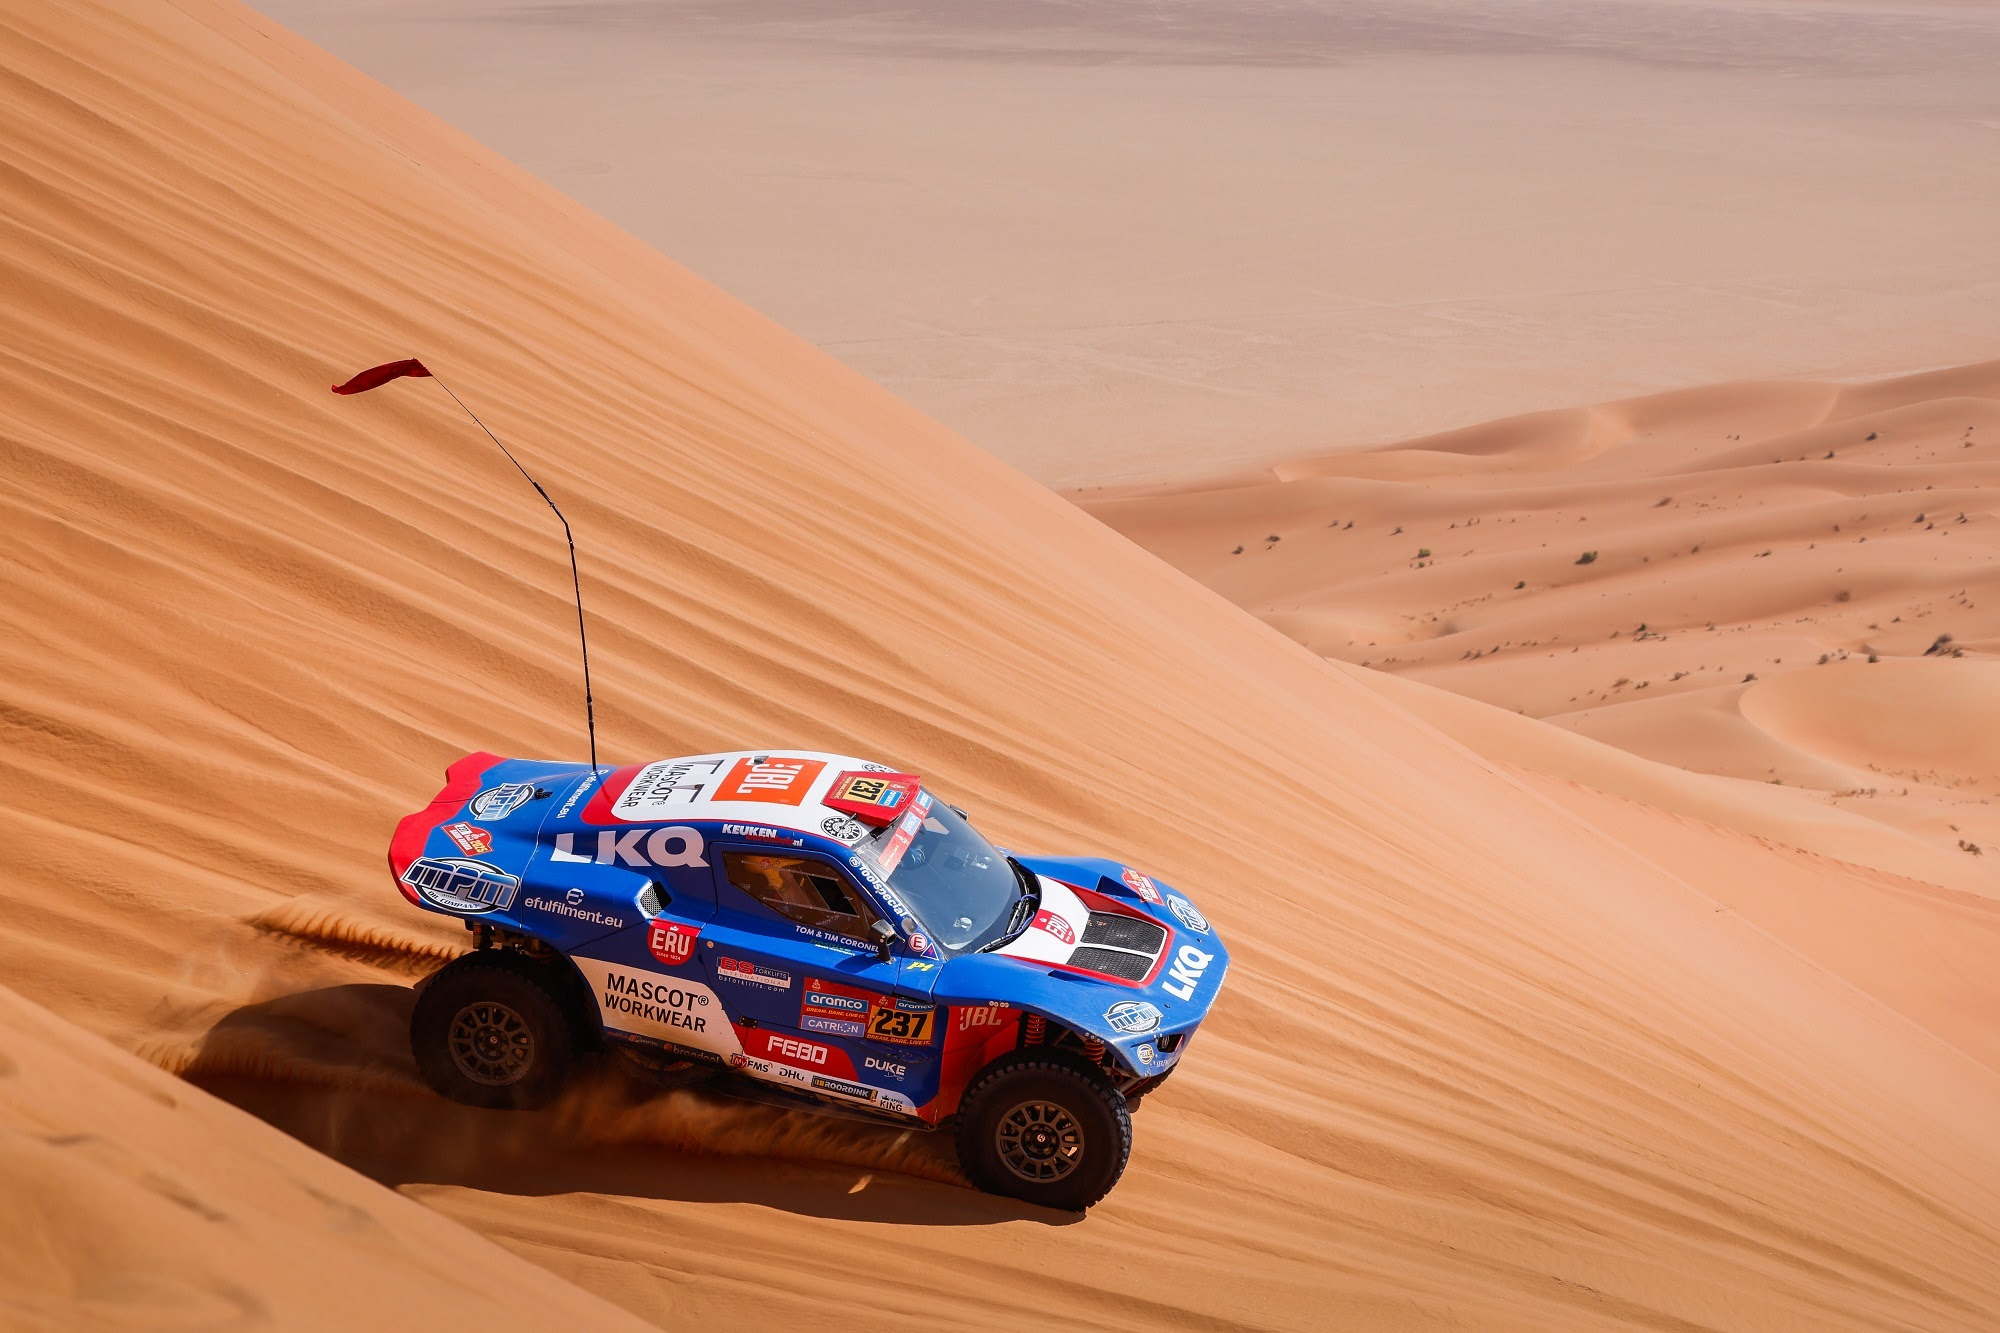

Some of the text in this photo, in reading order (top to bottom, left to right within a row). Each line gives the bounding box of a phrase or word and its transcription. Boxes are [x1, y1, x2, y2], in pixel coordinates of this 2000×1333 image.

[620, 763, 671, 808] WORKWEAR
[736, 763, 803, 794] JBL
[848, 779, 885, 801] 237
[722, 823, 777, 839] KEUKEN
[550, 826, 710, 868] LKQ
[859, 865, 909, 917] Toolspecial
[440, 898, 480, 909] COMPANY
[524, 896, 623, 929] efulfilment.eu
[652, 928, 690, 956] ERU
[795, 925, 815, 937] TOM
[816, 931, 823, 939] &
[824, 932, 838, 943] TIM
[840, 937, 879, 953] CORONEL
[656, 951, 669, 959] Since
[719, 970, 786, 986] INTERNATIONAL
[720, 956, 787, 979] BS FORKLIFTS
[1162, 945, 1215, 1002] LKQ
[718, 975, 785, 993] bsforklifts.com
[605, 992, 706, 1033] WORKWEAR
[806, 1007, 828, 1015] DREAM.
[810, 994, 863, 1010] aramco
[898, 1002, 934, 1010] aramco
[874, 1008, 928, 1039] 237
[959, 1007, 1002, 1031] JBL
[767, 1035, 828, 1065] FEBO
[867, 1034, 889, 1042] DREAM.
[890, 1037, 909, 1045] DARE.
[864, 1056, 906, 1077] DUKE
[824, 1081, 869, 1098] ROORDINK
[879, 1100, 903, 1112] KING
